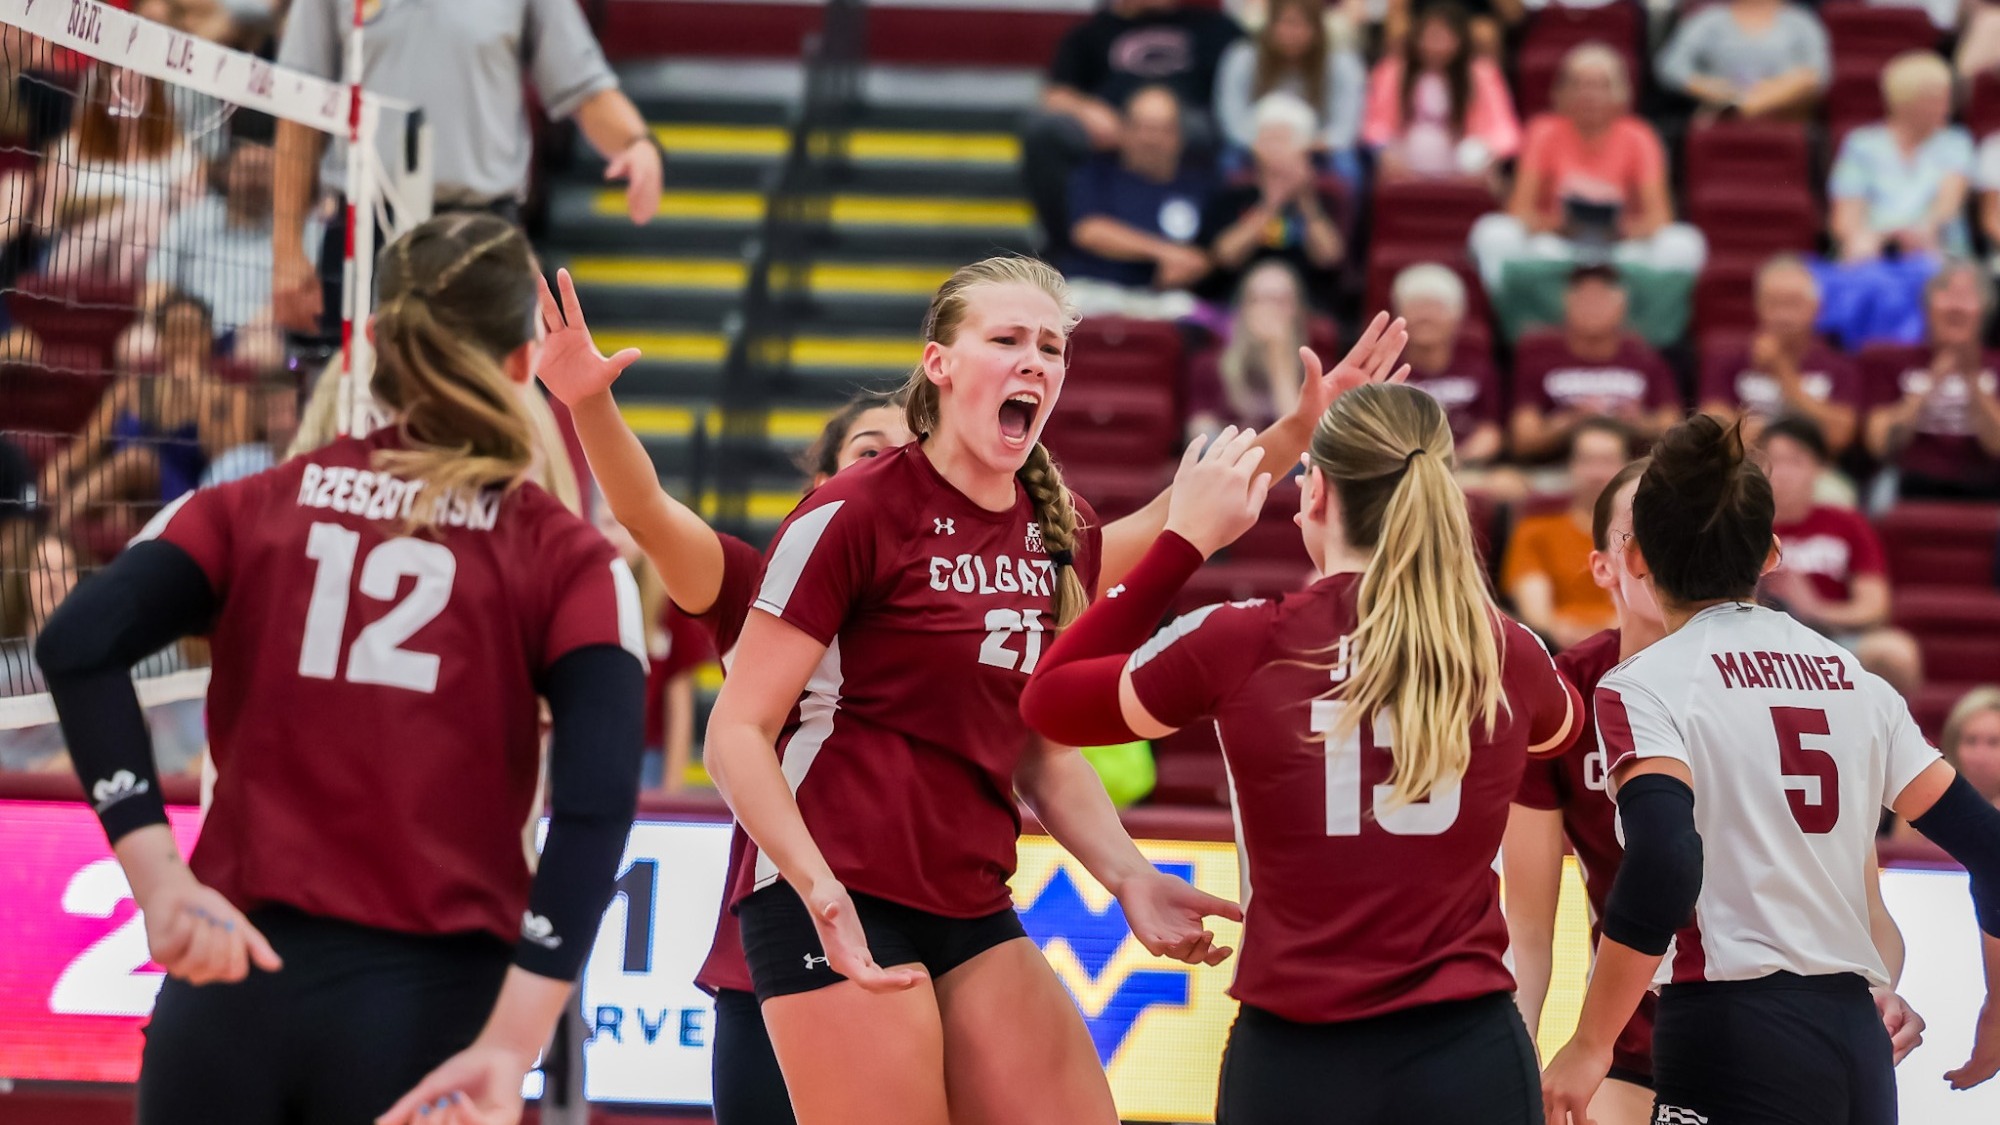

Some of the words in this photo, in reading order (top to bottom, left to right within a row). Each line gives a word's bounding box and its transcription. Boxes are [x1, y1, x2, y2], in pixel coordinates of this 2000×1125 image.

[298, 521, 457, 694] 12
[929, 553, 1056, 597] COLGAT
[978, 608, 1044, 675] 21
[1711, 651, 1855, 691] MARTINEZ
[1769, 706, 1840, 834] 5
[49, 858, 168, 1017] 2
[595, 1005, 706, 1047] RVE
